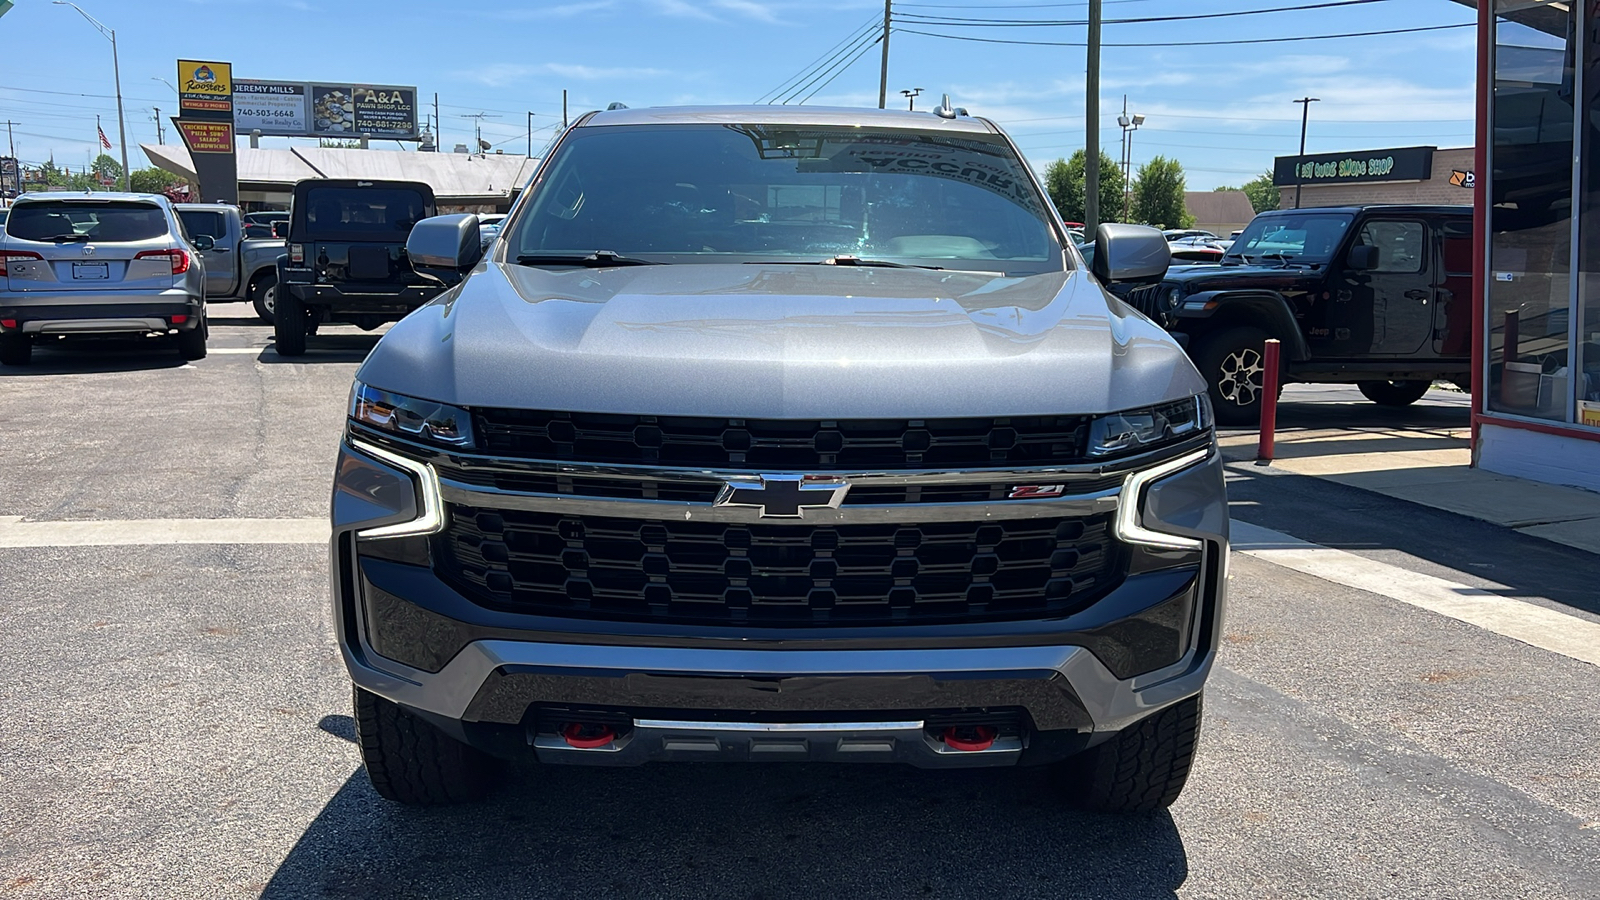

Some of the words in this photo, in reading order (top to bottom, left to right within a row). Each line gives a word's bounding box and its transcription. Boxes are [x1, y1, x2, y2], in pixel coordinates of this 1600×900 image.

[185, 79, 226, 92] Roosters
[235, 84, 268, 93] JEREMY
[269, 86, 295, 94] MILLS
[364, 89, 404, 104] A&A
[237, 108, 295, 118] 740-503-6648
[274, 119, 292, 128] Realty
[1368, 156, 1394, 175] SHOP
[1309, 327, 1330, 337] Jeep
[1008, 485, 1065, 498] Z71
